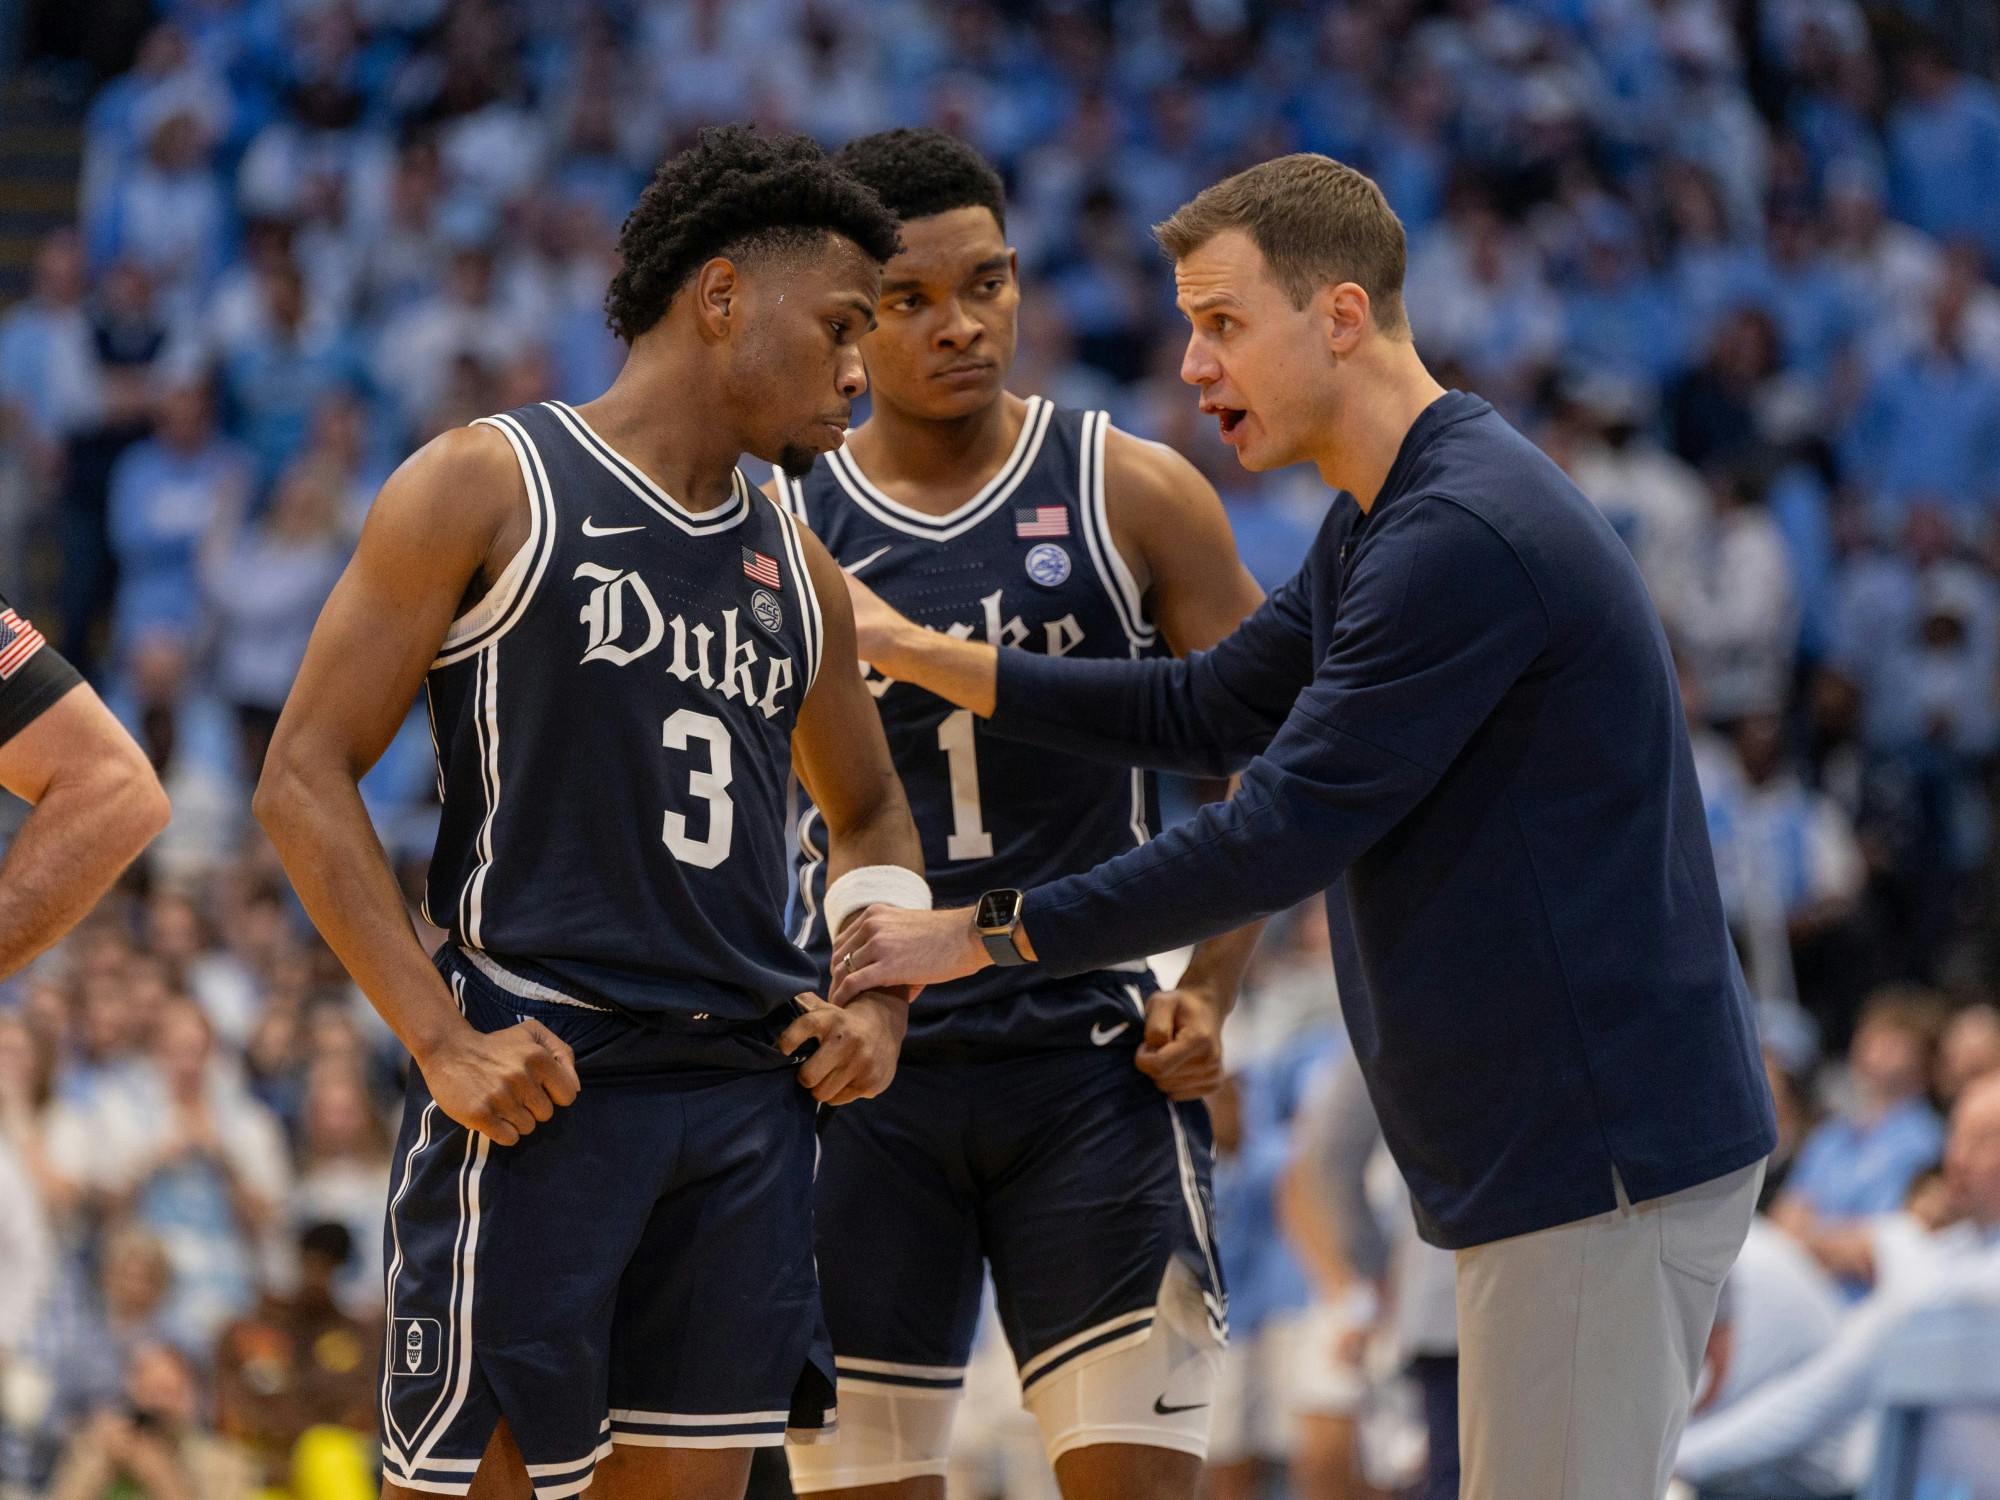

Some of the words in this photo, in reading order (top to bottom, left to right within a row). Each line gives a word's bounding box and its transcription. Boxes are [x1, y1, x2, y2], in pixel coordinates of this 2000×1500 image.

[573, 562, 793, 719] Duke
[662, 708, 734, 869] 3
[937, 709, 994, 860] 1
